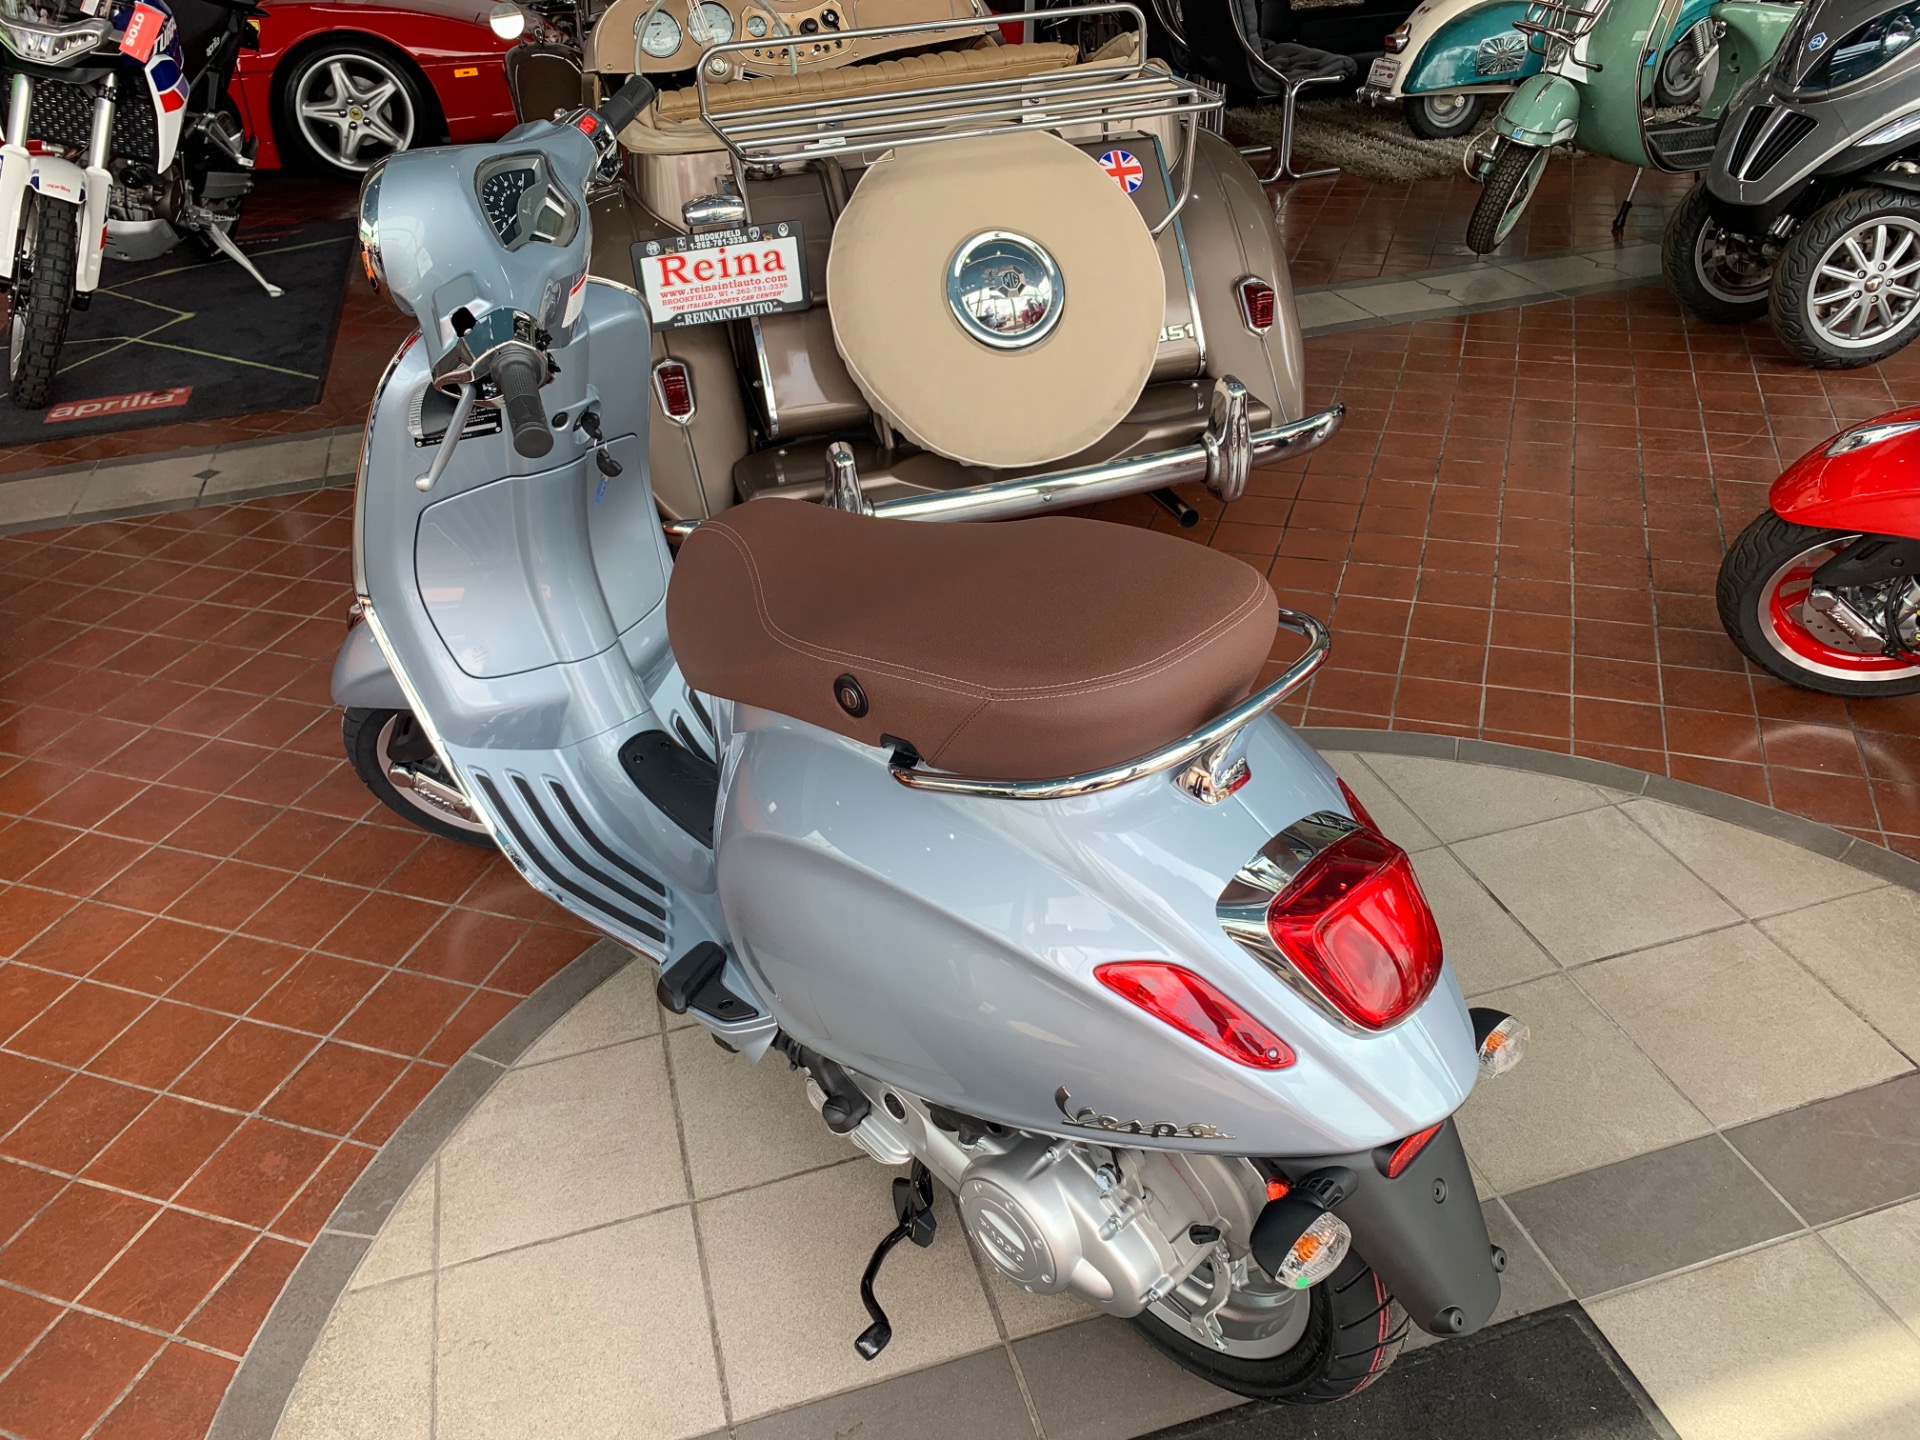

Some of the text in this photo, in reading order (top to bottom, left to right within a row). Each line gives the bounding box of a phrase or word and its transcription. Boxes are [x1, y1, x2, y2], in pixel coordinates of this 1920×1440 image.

[125, 12, 145, 47] SOLD
[689, 235, 748, 250] 1-262-781-3336
[694, 229, 741, 243] BROOKFIELD
[656, 247, 786, 288] Reina
[660, 274, 788, 299] www.reinaintlauto.com
[1003, 271, 1021, 289] MG
[662, 282, 789, 306] BROOKFIELD, WI 262-781-3336
[687, 300, 713, 310] ITALIAN
[714, 296, 740, 306] SPORTS
[741, 294, 756, 302] CAR
[50, 390, 176, 417] aprilia
